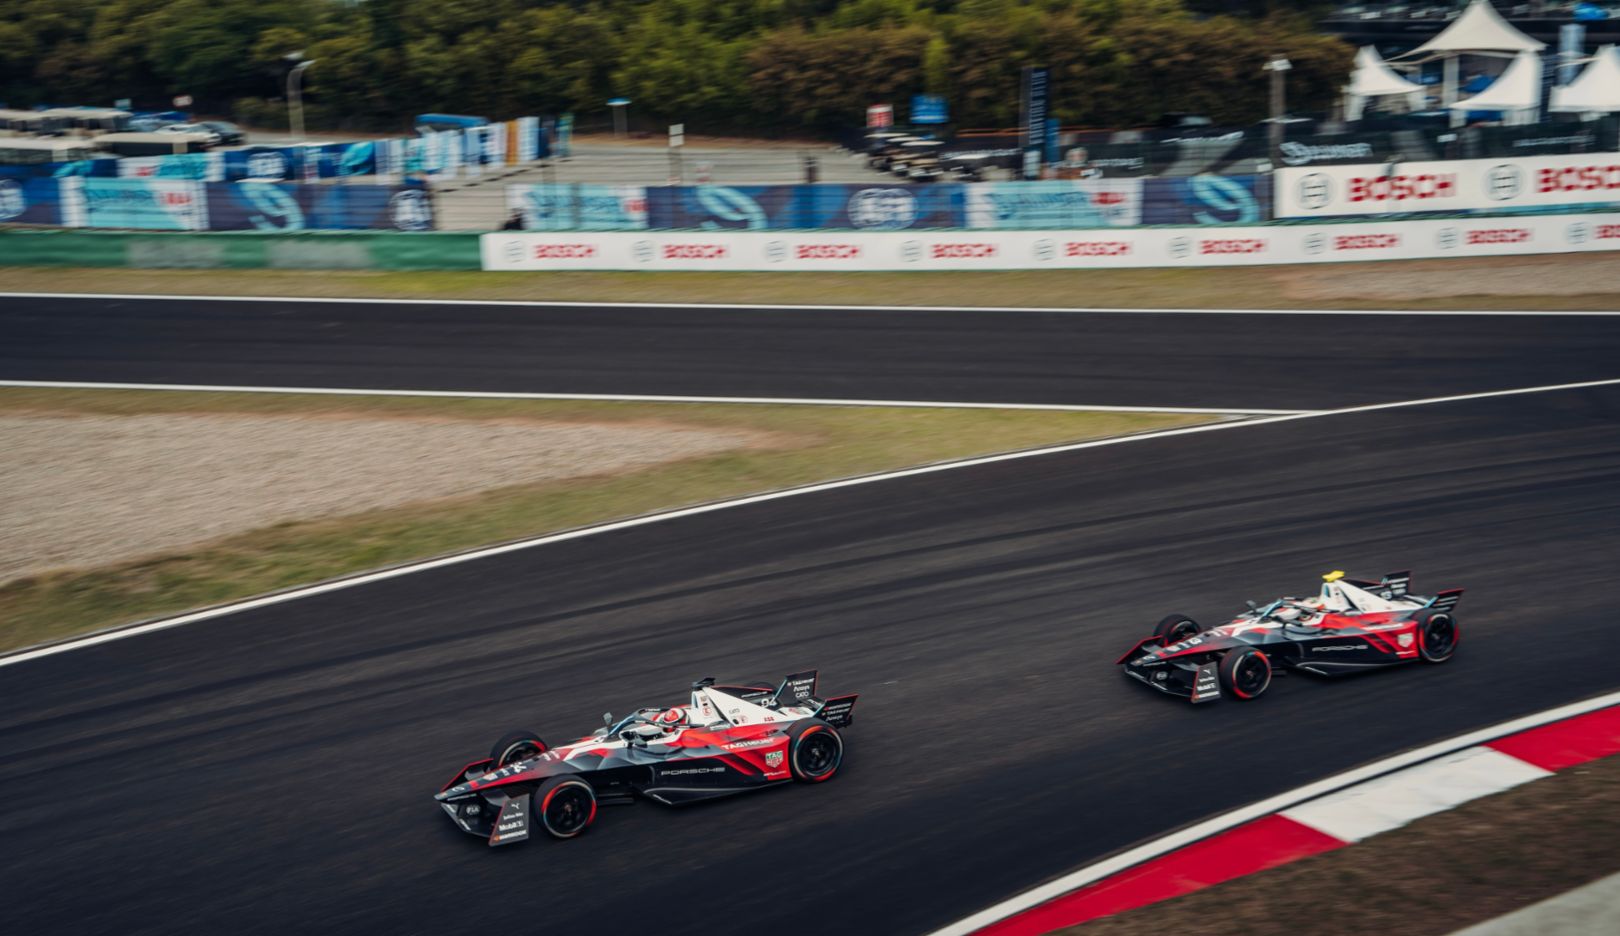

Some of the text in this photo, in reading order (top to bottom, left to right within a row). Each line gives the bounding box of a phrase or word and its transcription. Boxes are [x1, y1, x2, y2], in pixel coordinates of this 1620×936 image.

[1349, 174, 1456, 202] BOSCH
[1333, 233, 1401, 250] BOSCH
[1465, 228, 1532, 244] BOSCH
[532, 243, 598, 259] BOSCH
[661, 243, 729, 259] BOSCH
[795, 243, 862, 259] BOSCH
[930, 243, 996, 258] BOSCH
[1063, 241, 1132, 256] BOSCH
[1198, 238, 1267, 254] BOSCH
[661, 766, 726, 776] PORSCHE
